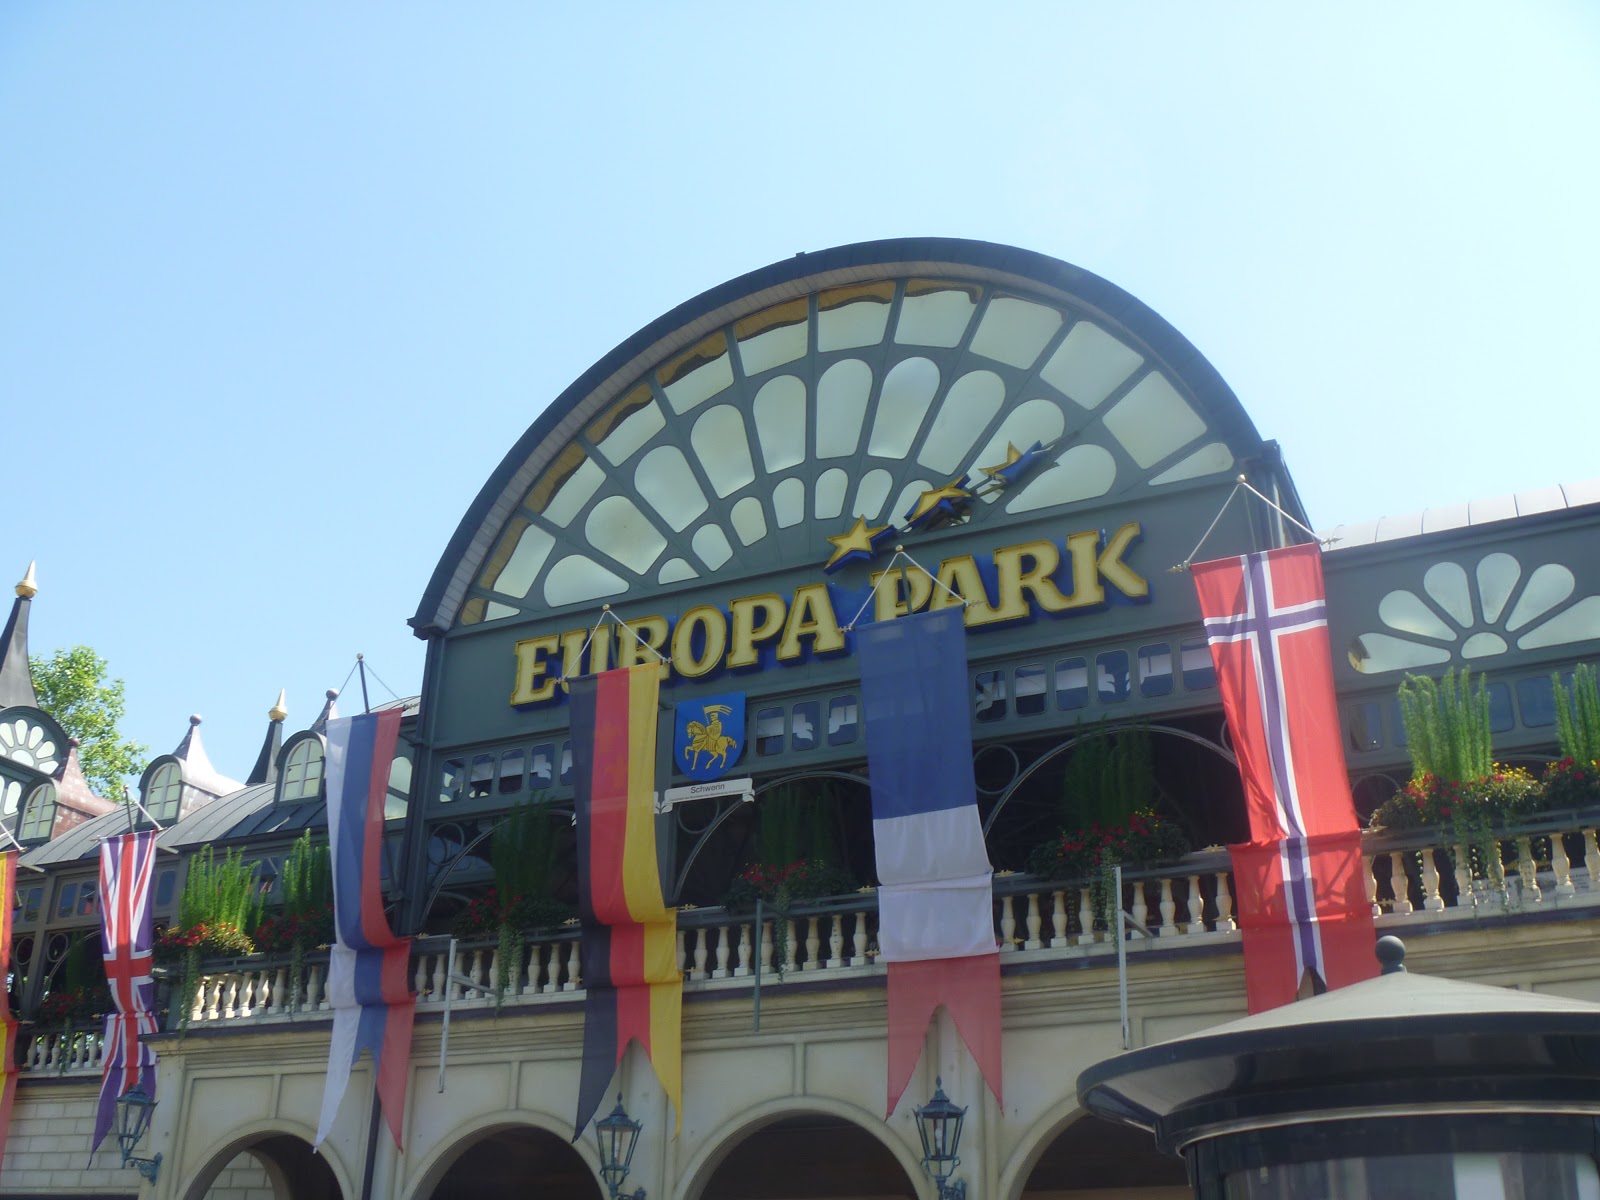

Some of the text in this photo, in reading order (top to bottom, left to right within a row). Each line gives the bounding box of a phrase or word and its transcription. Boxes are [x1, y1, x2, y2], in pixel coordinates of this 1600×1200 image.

[510, 520, 1149, 706] EUROPA PARK
[690, 783, 725, 794] Schwerin
